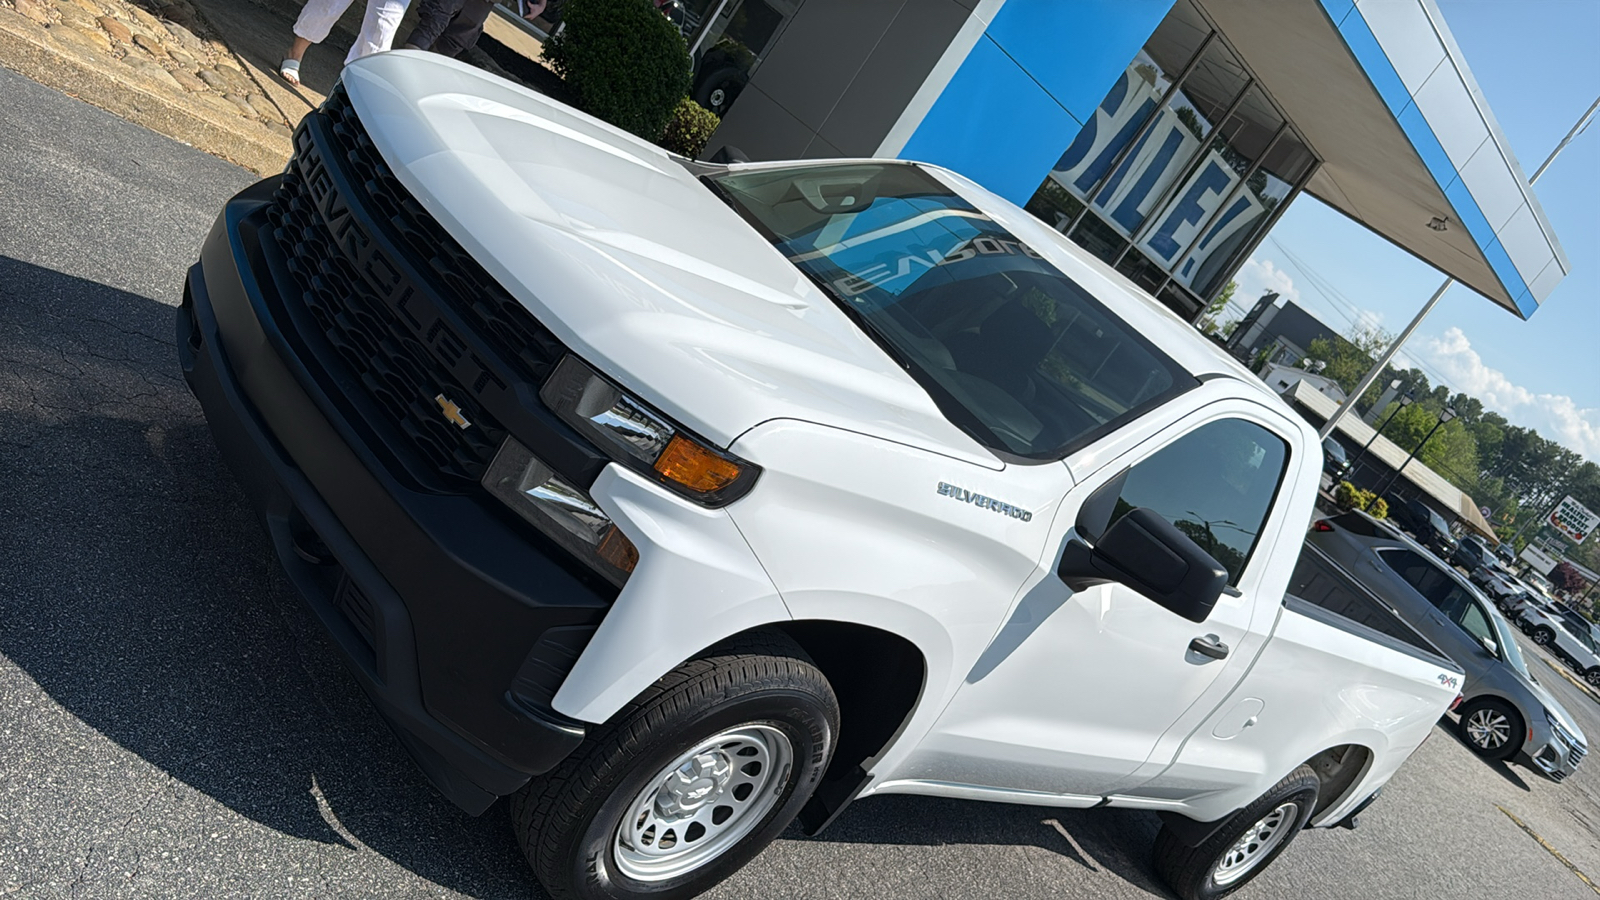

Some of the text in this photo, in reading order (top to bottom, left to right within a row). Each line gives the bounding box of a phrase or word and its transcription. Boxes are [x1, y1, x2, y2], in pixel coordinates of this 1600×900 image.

[295, 126, 507, 394] CHEVROLET
[936, 481, 1033, 523] SILVERADO
[1561, 501, 1589, 523] HEALTHY
[1558, 514, 1588, 537] PRODUCE
[1560, 508, 1588, 530] HARVEST
